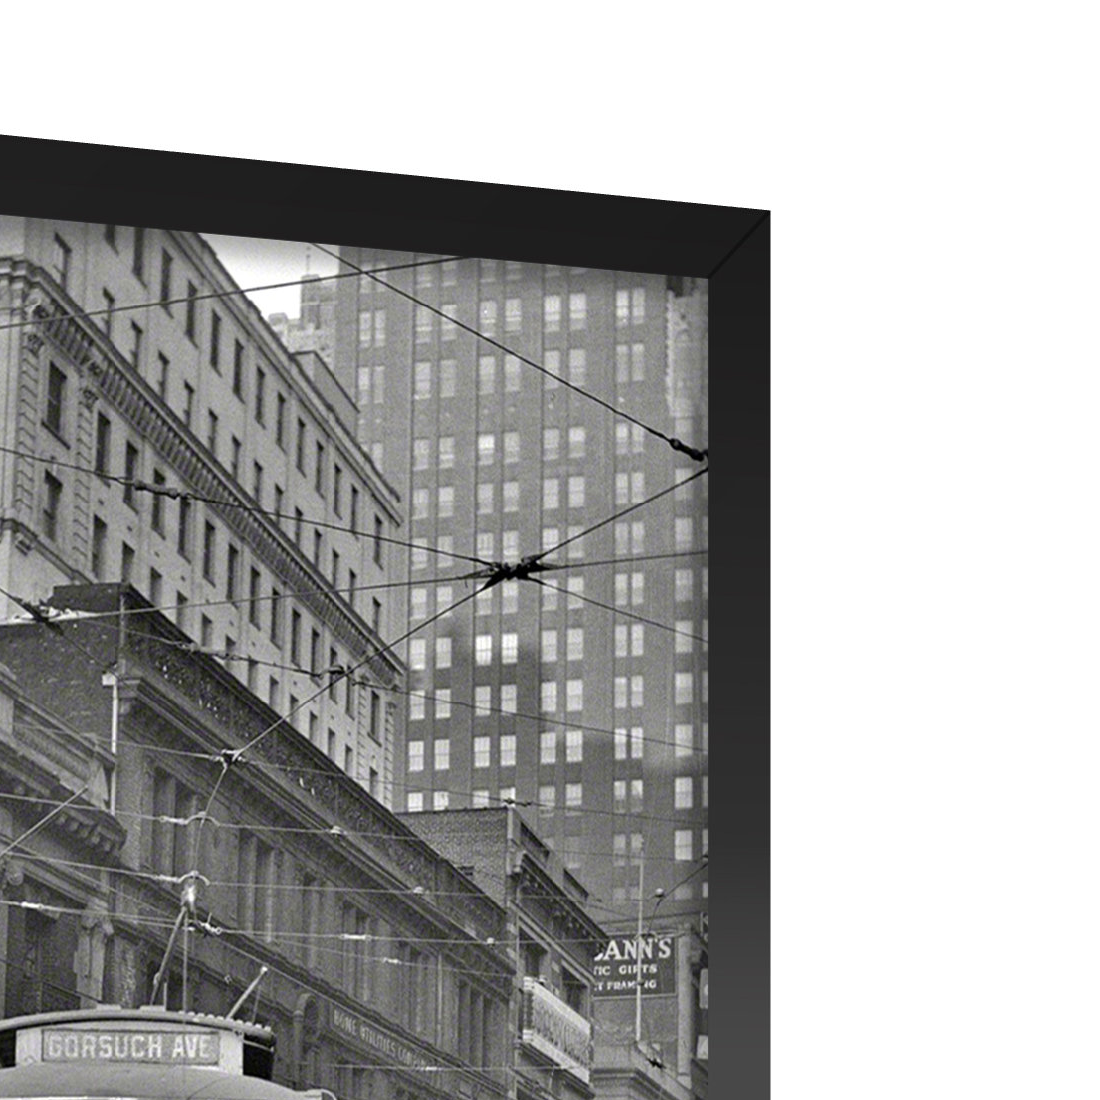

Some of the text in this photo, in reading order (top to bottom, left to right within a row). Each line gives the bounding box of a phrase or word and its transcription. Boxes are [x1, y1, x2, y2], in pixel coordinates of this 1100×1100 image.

[619, 963, 658, 975] GIFTS
[607, 979, 656, 990] FRAMNG
[49, 1034, 212, 1059] GORSUCH AVE
